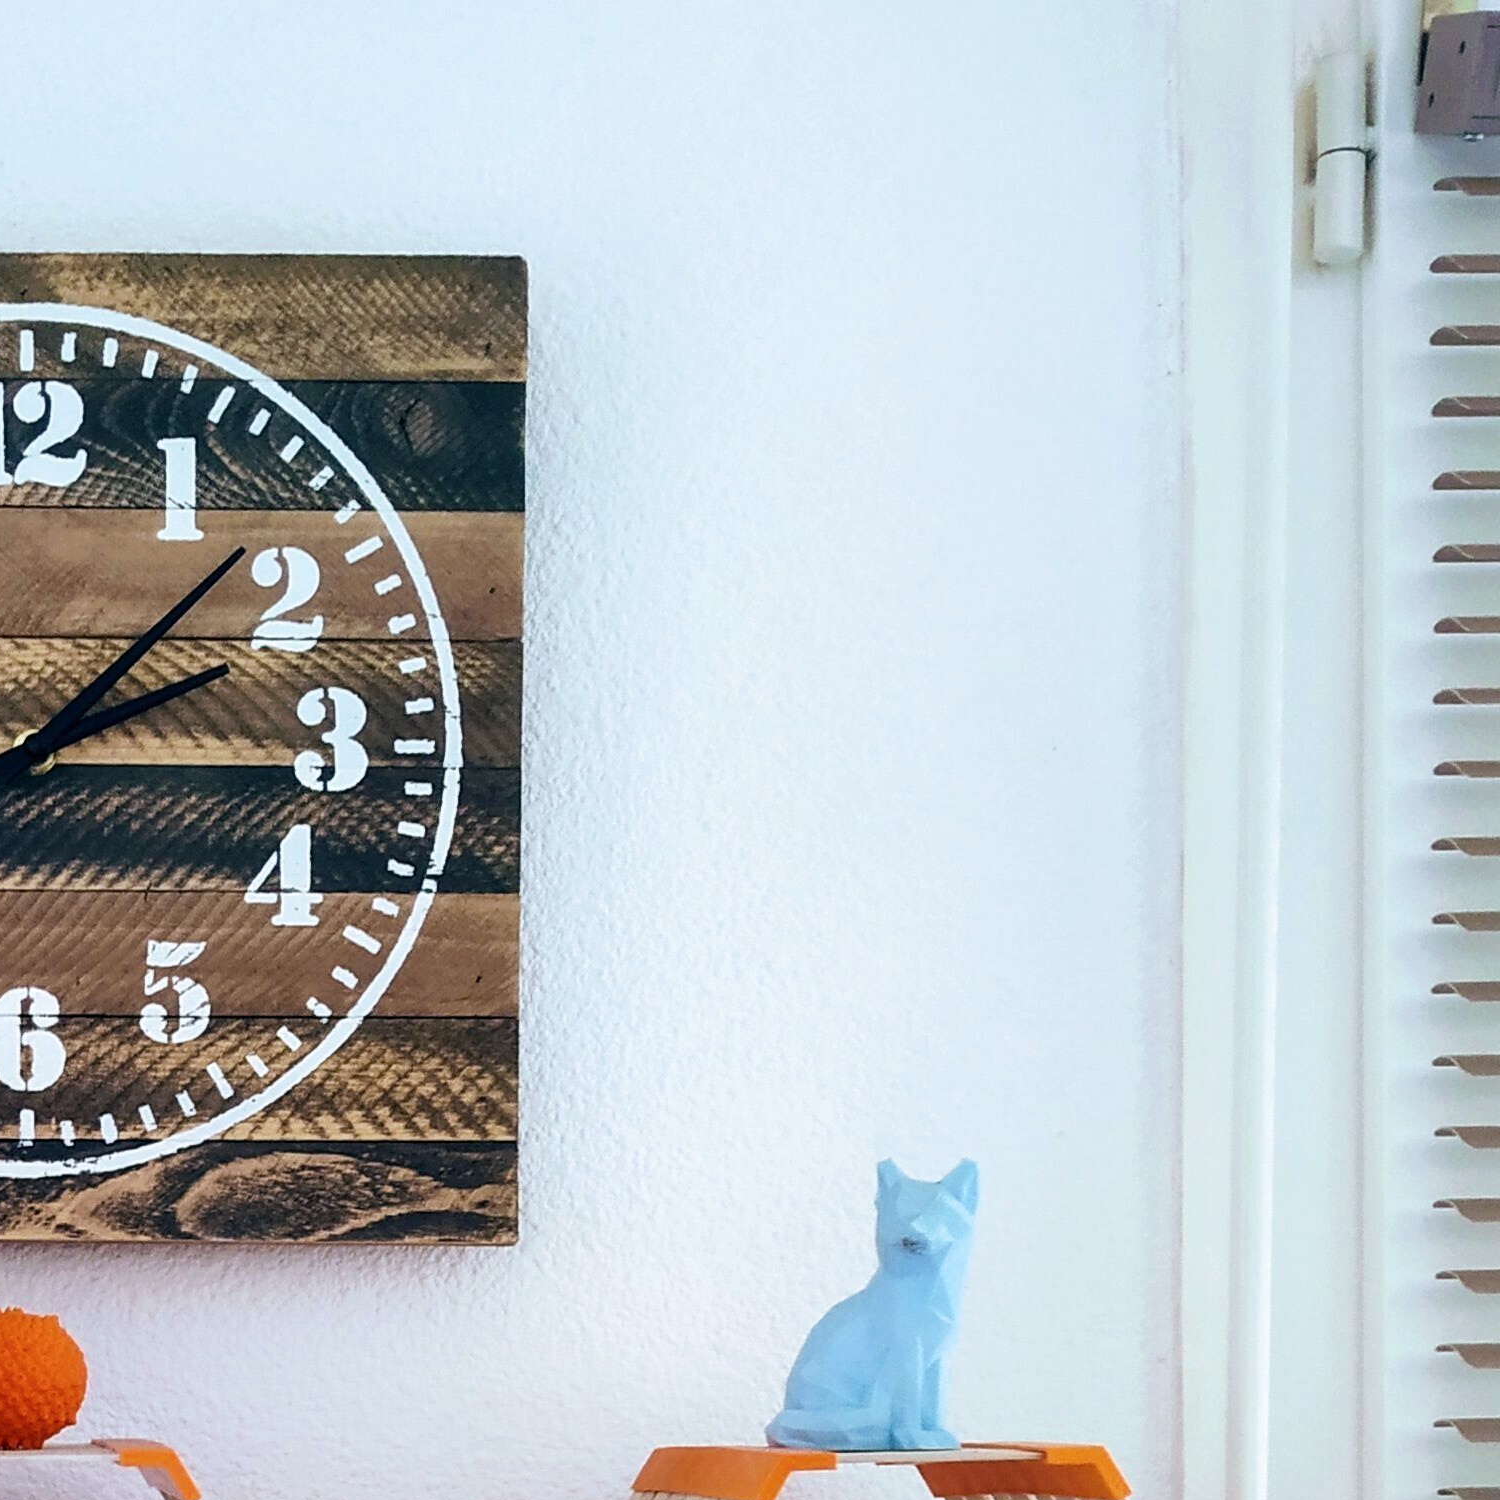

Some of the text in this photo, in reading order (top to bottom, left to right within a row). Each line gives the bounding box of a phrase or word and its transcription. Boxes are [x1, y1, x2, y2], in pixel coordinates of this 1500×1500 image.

[156, 437, 205, 542] 1
[250, 546, 324, 653] 2
[294, 686, 369, 792] 3
[243, 825, 323, 927] 4
[139, 940, 211, 1044] 5
